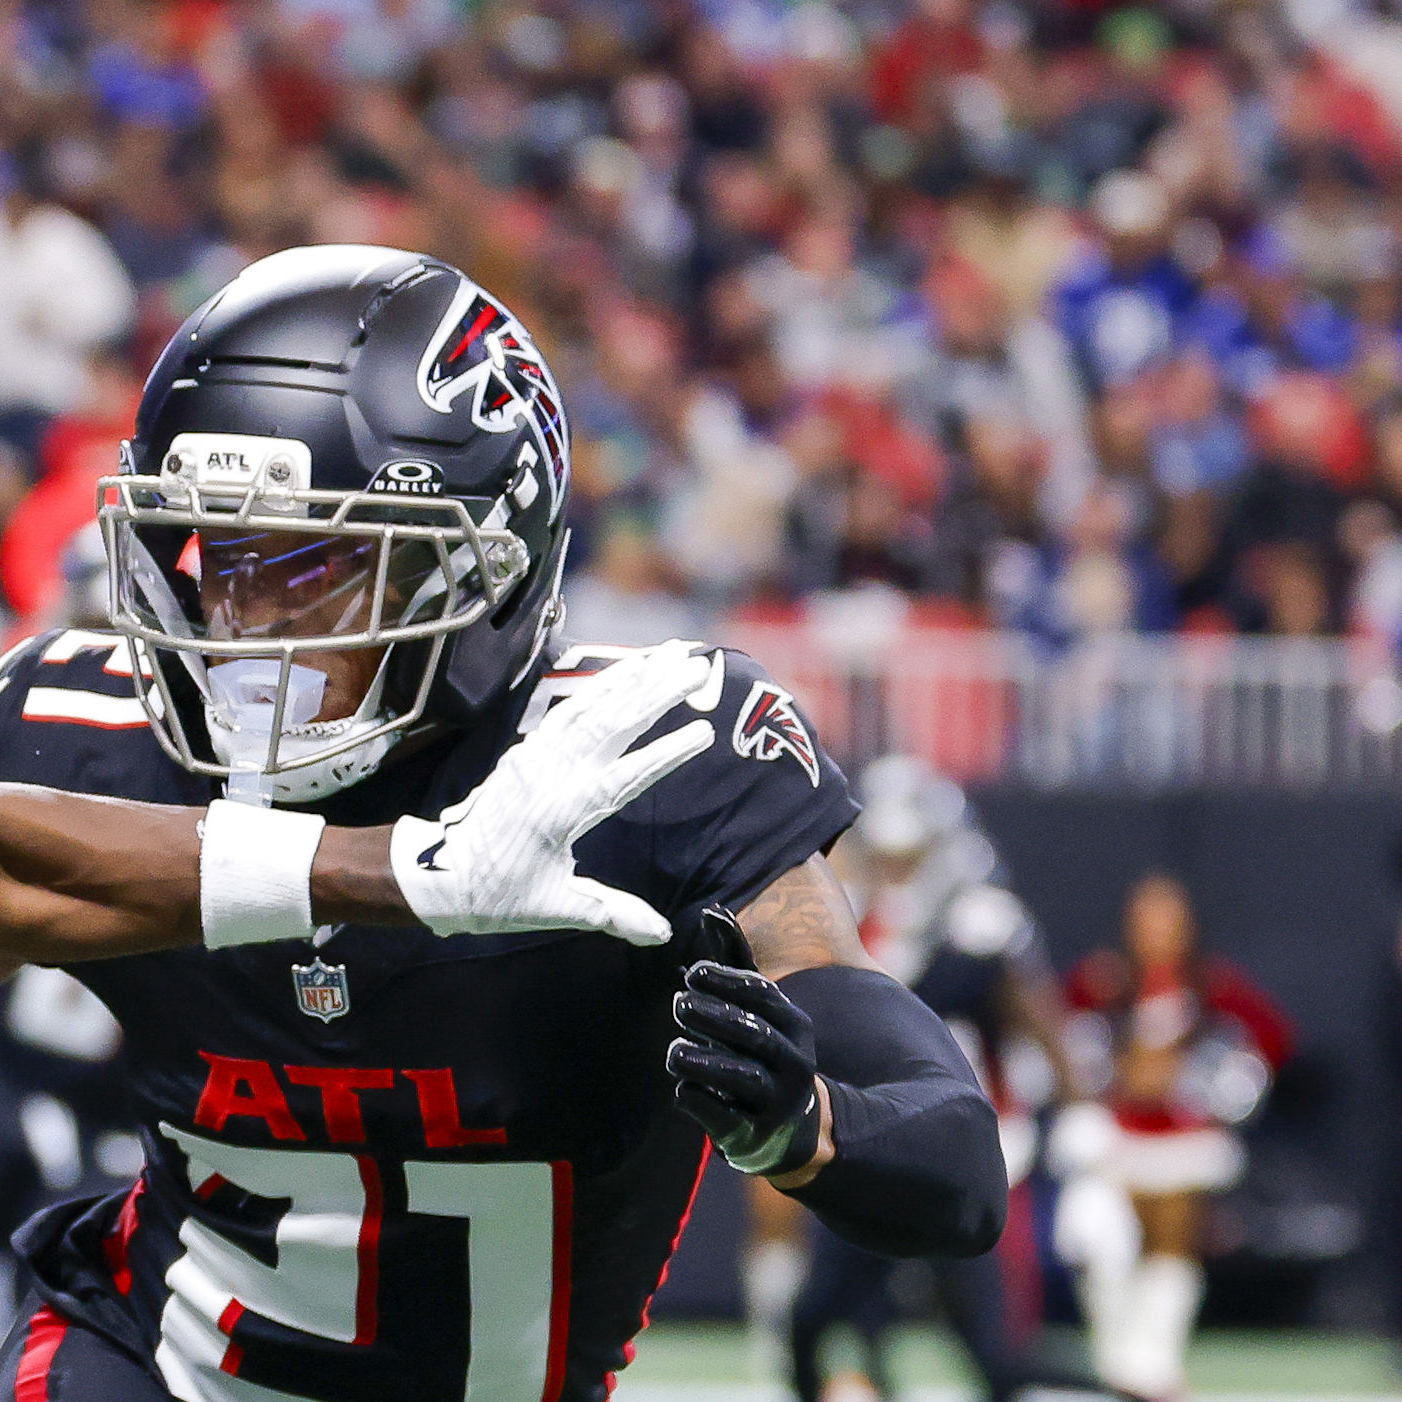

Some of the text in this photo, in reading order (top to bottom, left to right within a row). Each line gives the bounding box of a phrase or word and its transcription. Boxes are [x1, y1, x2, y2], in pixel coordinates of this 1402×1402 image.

[207, 452, 251, 472] ATL
[374, 479, 443, 494] OAKLEY
[303, 988, 342, 1012] NFL
[193, 1050, 508, 1149] ATL
